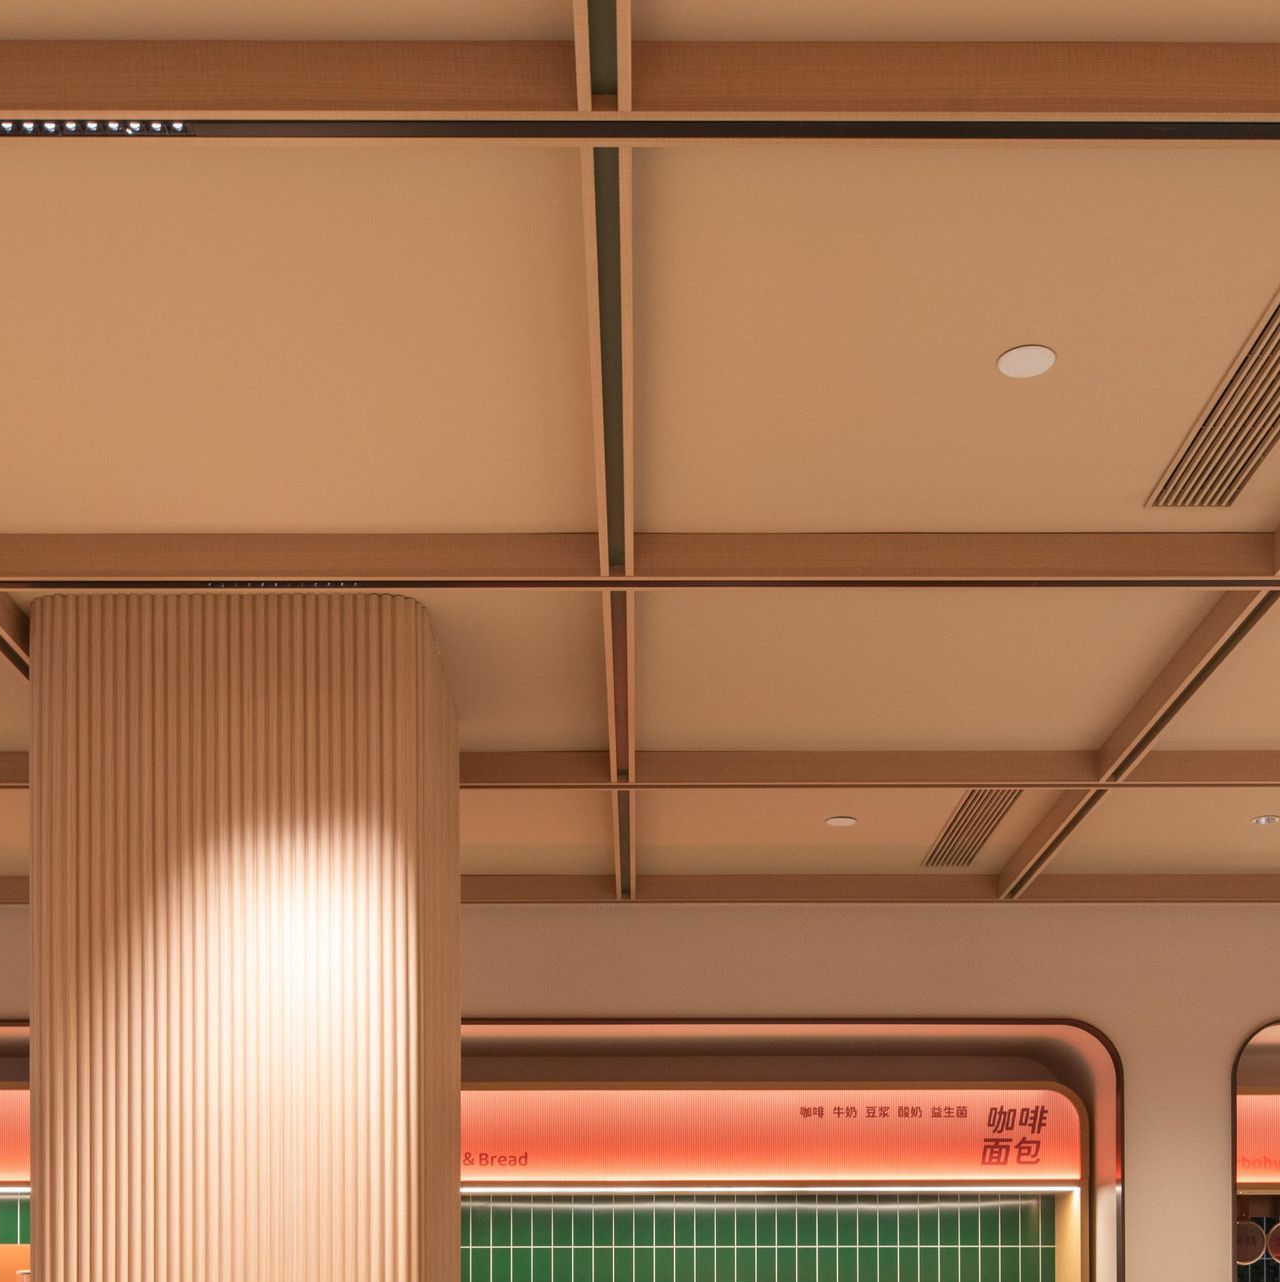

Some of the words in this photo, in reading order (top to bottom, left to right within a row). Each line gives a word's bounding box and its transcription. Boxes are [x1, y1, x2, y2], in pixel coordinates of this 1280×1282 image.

[799, 1106, 825, 1118] 咖啡
[832, 1106, 858, 1118] 牛奶
[865, 1106, 890, 1118] 豆浆
[897, 1106, 923, 1118] 酸奶
[930, 1106, 968, 1118] 益生菌
[987, 1105, 1048, 1134] 咖啡
[462, 1151, 475, 1166] &
[479, 1151, 528, 1166] Bread
[981, 1137, 1041, 1166] 面包
